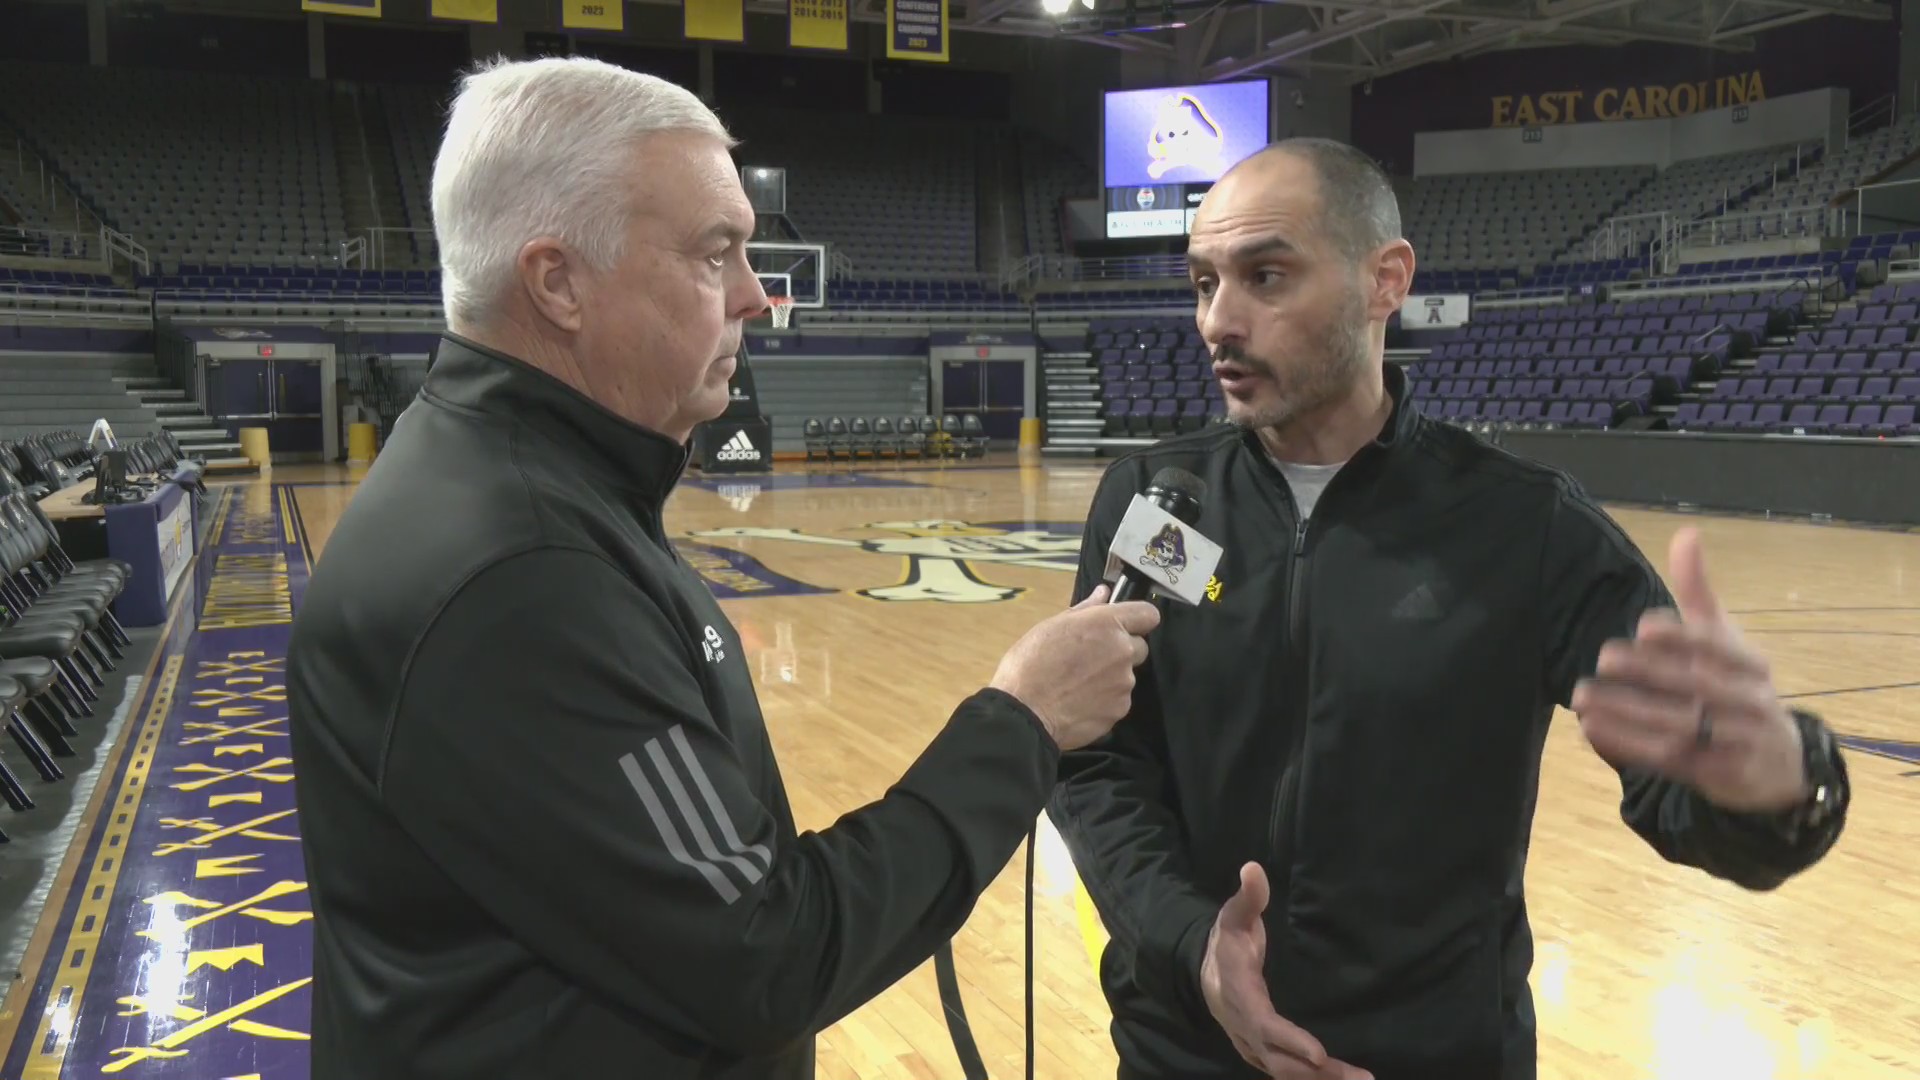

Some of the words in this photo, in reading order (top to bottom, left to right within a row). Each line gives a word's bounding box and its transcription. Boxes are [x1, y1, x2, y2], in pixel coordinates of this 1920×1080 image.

[1490, 91, 1583, 128] EAST
[1594, 69, 1767, 122] CAROLINA
[716, 448, 761, 461] adidas
